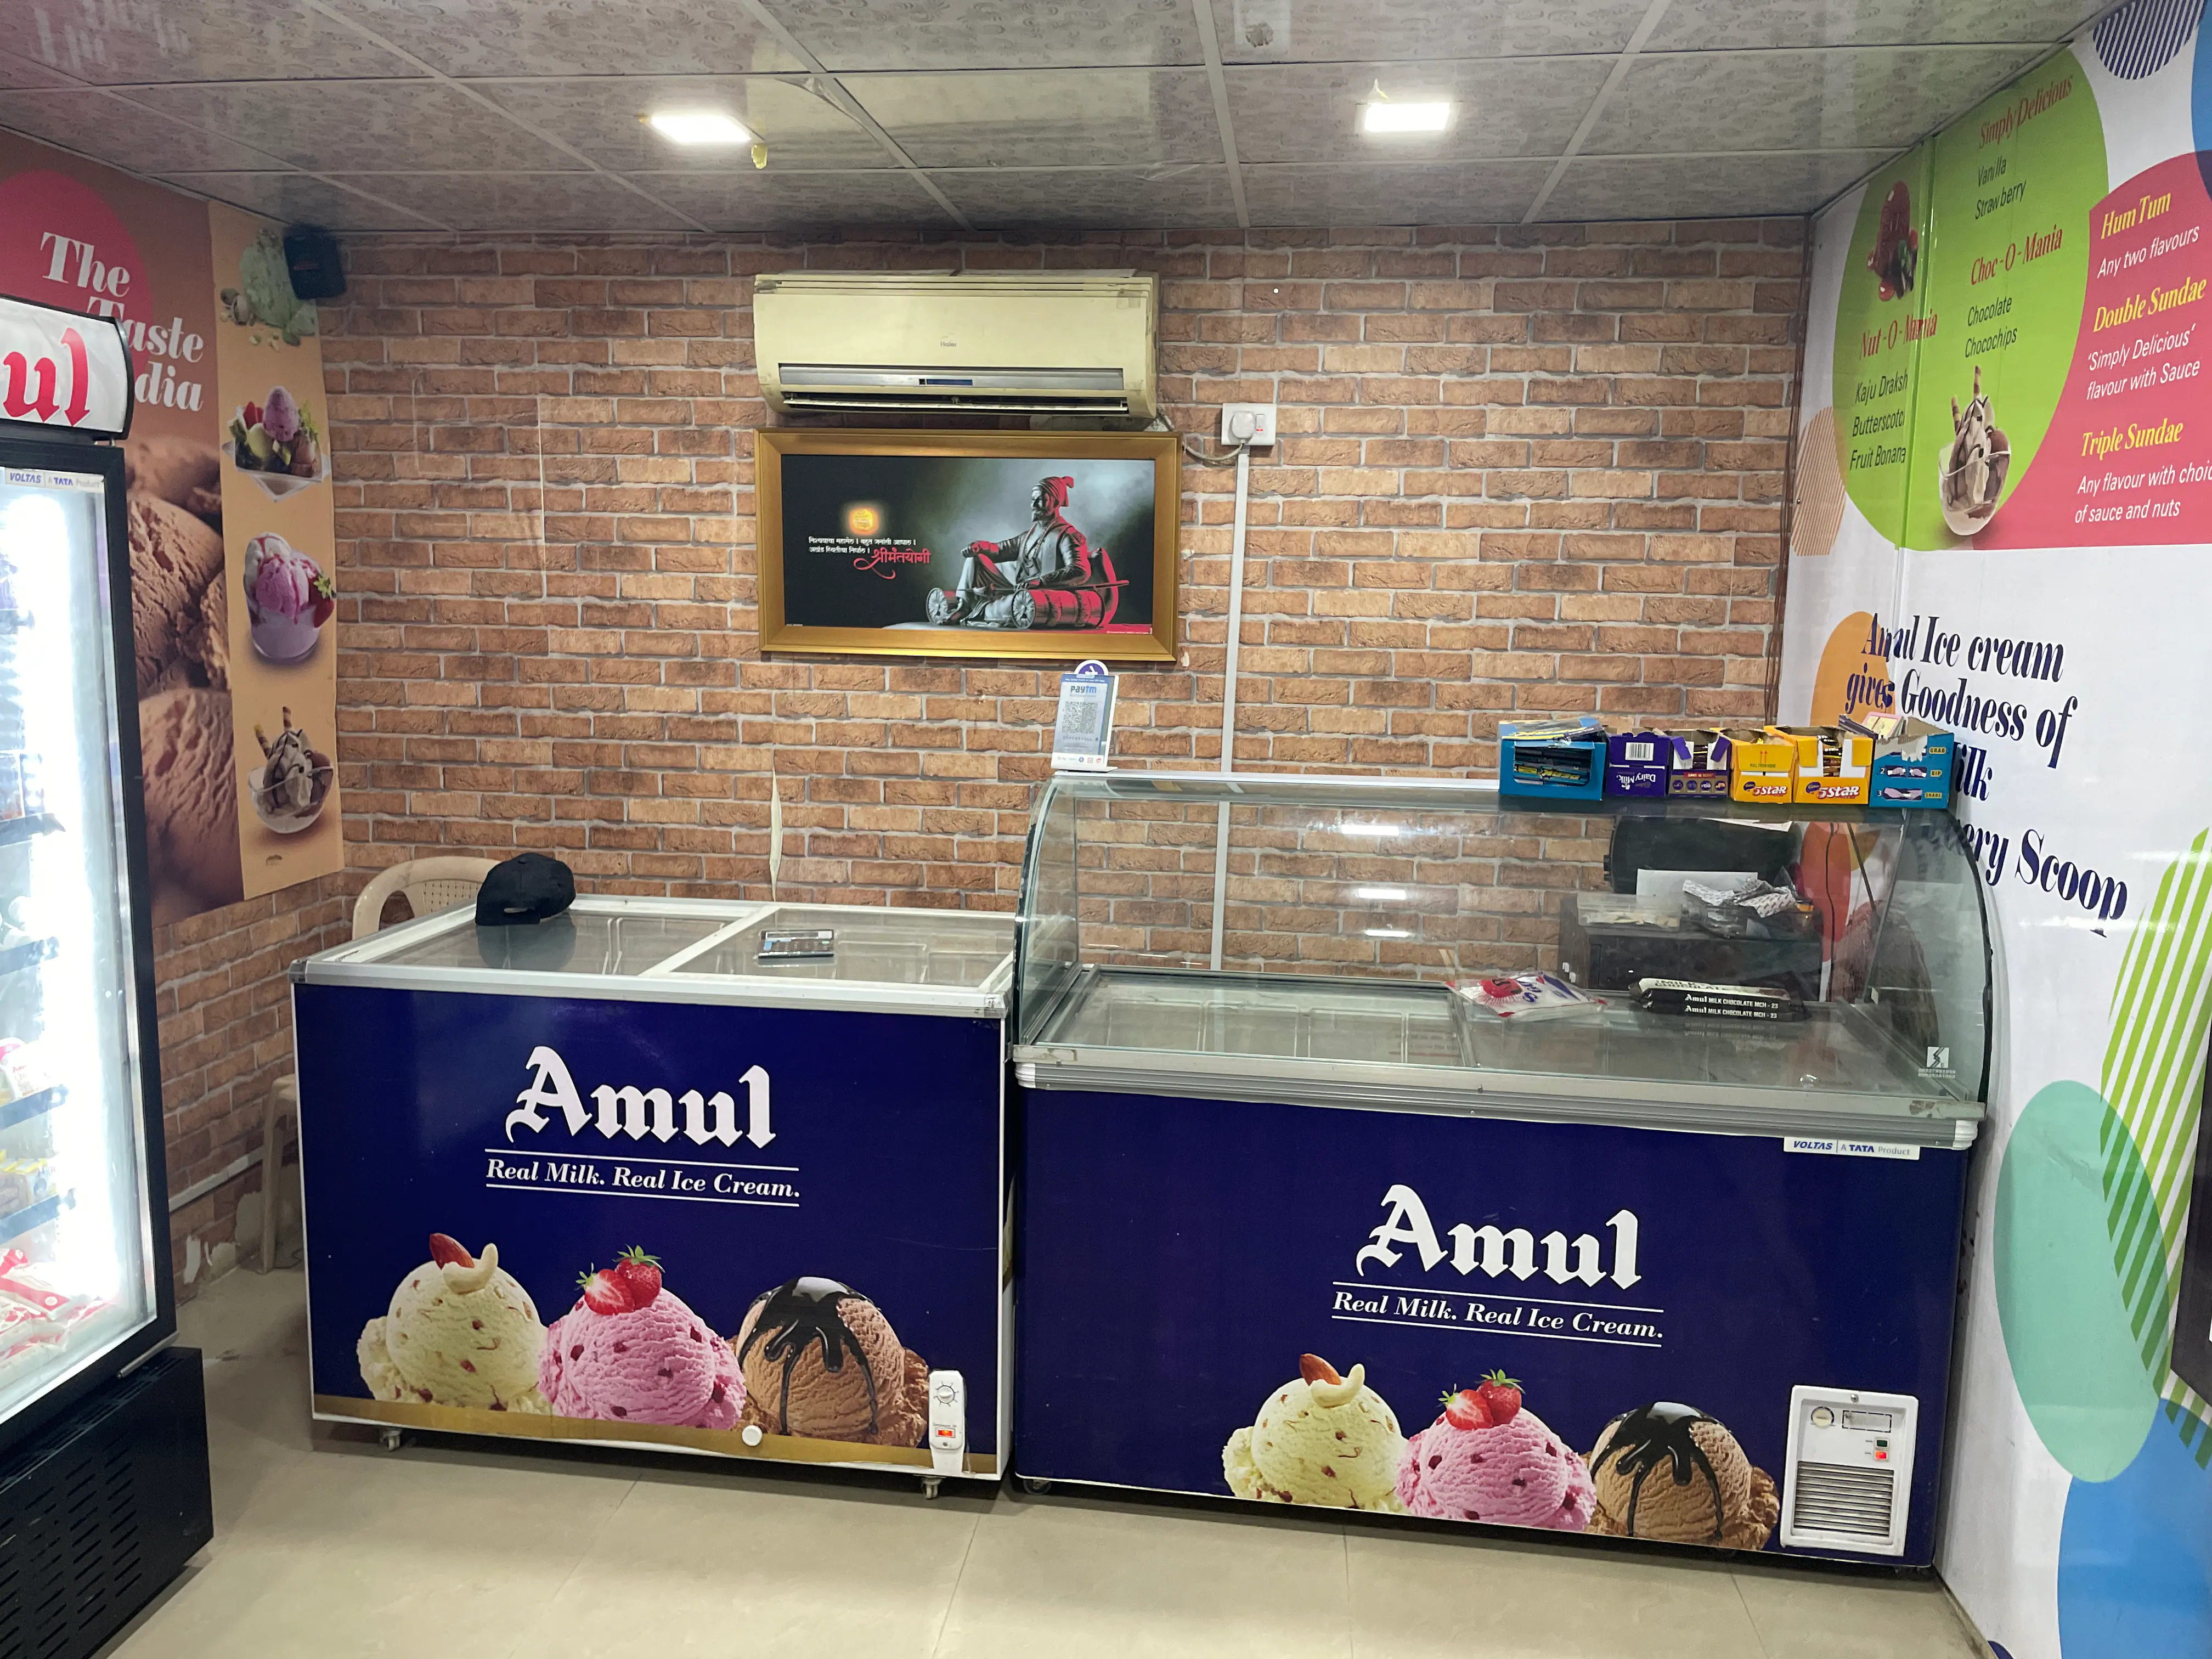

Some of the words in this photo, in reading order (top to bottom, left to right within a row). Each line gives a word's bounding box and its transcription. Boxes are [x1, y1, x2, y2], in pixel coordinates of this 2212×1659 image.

[1979, 106, 2017, 149] Simply
[2017, 74, 2073, 127] Delicious
[1978, 155, 2007, 187] Vanilla
[1975, 179, 2027, 219] Strawberry
[2101, 208, 2137, 239] Hum
[2138, 193, 2171, 223] Tum
[40, 232, 130, 297] The
[2097, 256, 2121, 279] Any
[2124, 250, 2146, 268] two
[2149, 225, 2199, 259] flavours
[1968, 296, 2012, 326] Chocolate
[2093, 294, 2146, 332] Double
[2148, 276, 2207, 315] Sundae
[1965, 326, 2017, 358] Chocochips
[2, 328, 91, 426] ul
[135, 361, 204, 411] dia
[1855, 379, 1876, 405] Kaju
[1878, 368, 1909, 397] Draksh
[2086, 378, 2128, 400] flavour
[2130, 366, 2157, 390] with
[2160, 360, 2200, 383] Sauce
[1850, 446, 1873, 470] Fruit
[2081, 427, 2123, 461] Triple
[2124, 417, 2183, 449] Sundae
[10, 472, 41, 483] VOLTAS
[54, 477, 73, 486] TATA
[2077, 476, 2101, 497] Any
[2102, 472, 2146, 491] flavour
[2148, 465, 2175, 487] with
[2075, 504, 2089, 523] of
[2089, 506, 2123, 522] sauce
[2126, 499, 2151, 520] and
[2152, 499, 2181, 517] nuts
[1921, 616, 1960, 668] Ice
[1968, 636, 2064, 682] cream
[1901, 669, 2027, 741] Goodness
[2036, 696, 2078, 769] of
[1618, 774, 1635, 784] Milk
[1635, 772, 1656, 782] Dairy
[1954, 742, 1993, 801] ilk
[2015, 830, 2128, 938] Scoop
[1685, 994, 1707, 1002] Amul
[1723, 998, 1753, 1007] CHOCOLATE
[1685, 1005, 1707, 1013] Amul
[505, 1046, 776, 1148] Amul
[1793, 1141, 1833, 1150] VOLTAS
[1849, 1144, 1874, 1153] TATA
[1878, 1146, 1910, 1155] Product
[486, 1158, 539, 1181] Real
[544, 1162, 605, 1185] Milk.
[612, 1166, 665, 1189] Real
[671, 1170, 706, 1192] Ice
[714, 1173, 800, 1198] Cream.
[1356, 1184, 1641, 1290] Amul
[1332, 1291, 1387, 1314] Real
[1394, 1296, 1457, 1321] Milk.
[1465, 1303, 1520, 1327] Real
[1527, 1308, 1564, 1329] Ice
[1572, 1312, 1663, 1339] Cream.
